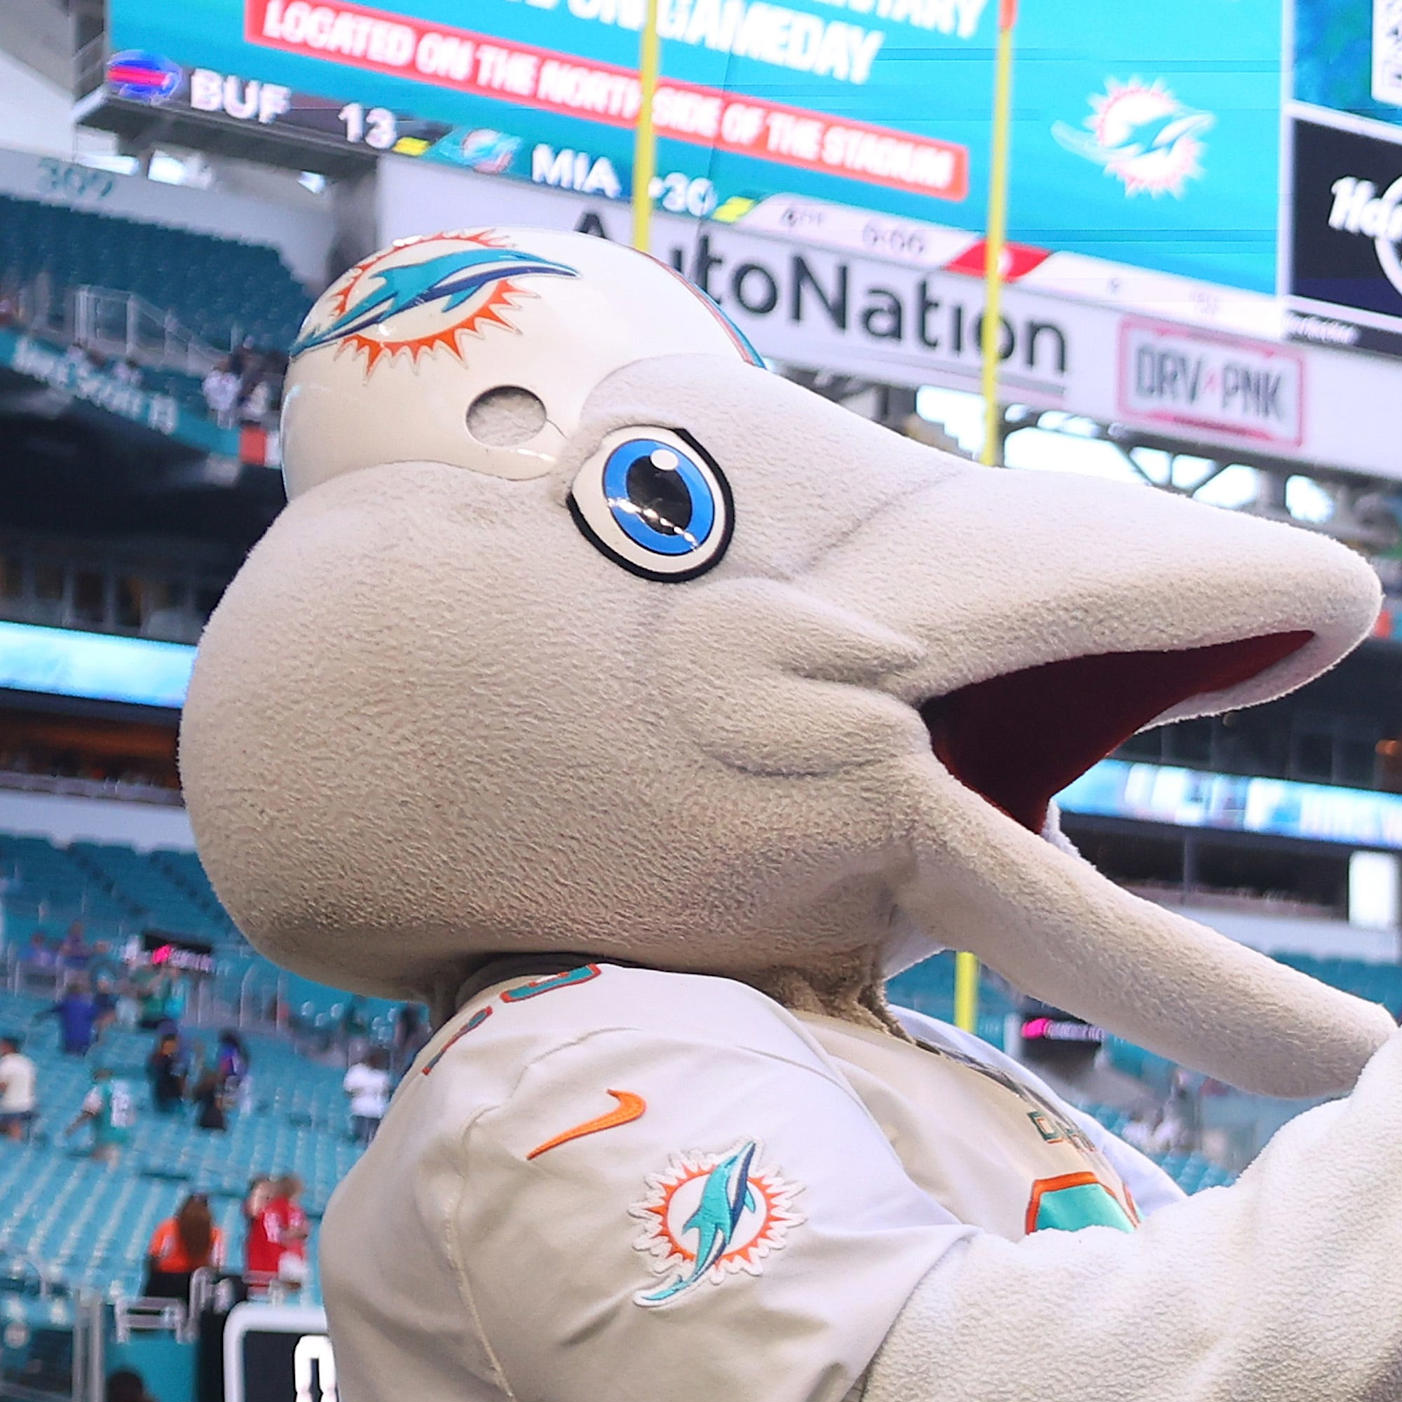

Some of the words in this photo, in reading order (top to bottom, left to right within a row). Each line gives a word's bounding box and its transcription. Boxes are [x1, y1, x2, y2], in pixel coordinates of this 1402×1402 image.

[263, 1, 416, 67] LOCATED
[416, 31, 472, 82] ON
[475, 45, 539, 98] THE
[652, 85, 723, 138] SIDE
[720, 103, 767, 146] OF
[767, 111, 824, 156] THE
[823, 126, 956, 190] STADIUM
[655, 0, 884, 84] GAMEDAY
[190, 68, 291, 124] BUF
[337, 102, 398, 150] 13
[532, 144, 622, 199] MIA
[577, 210, 1068, 376] toNation
[1132, 342, 1203, 401] DRV
[1218, 366, 1287, 420] PNK
